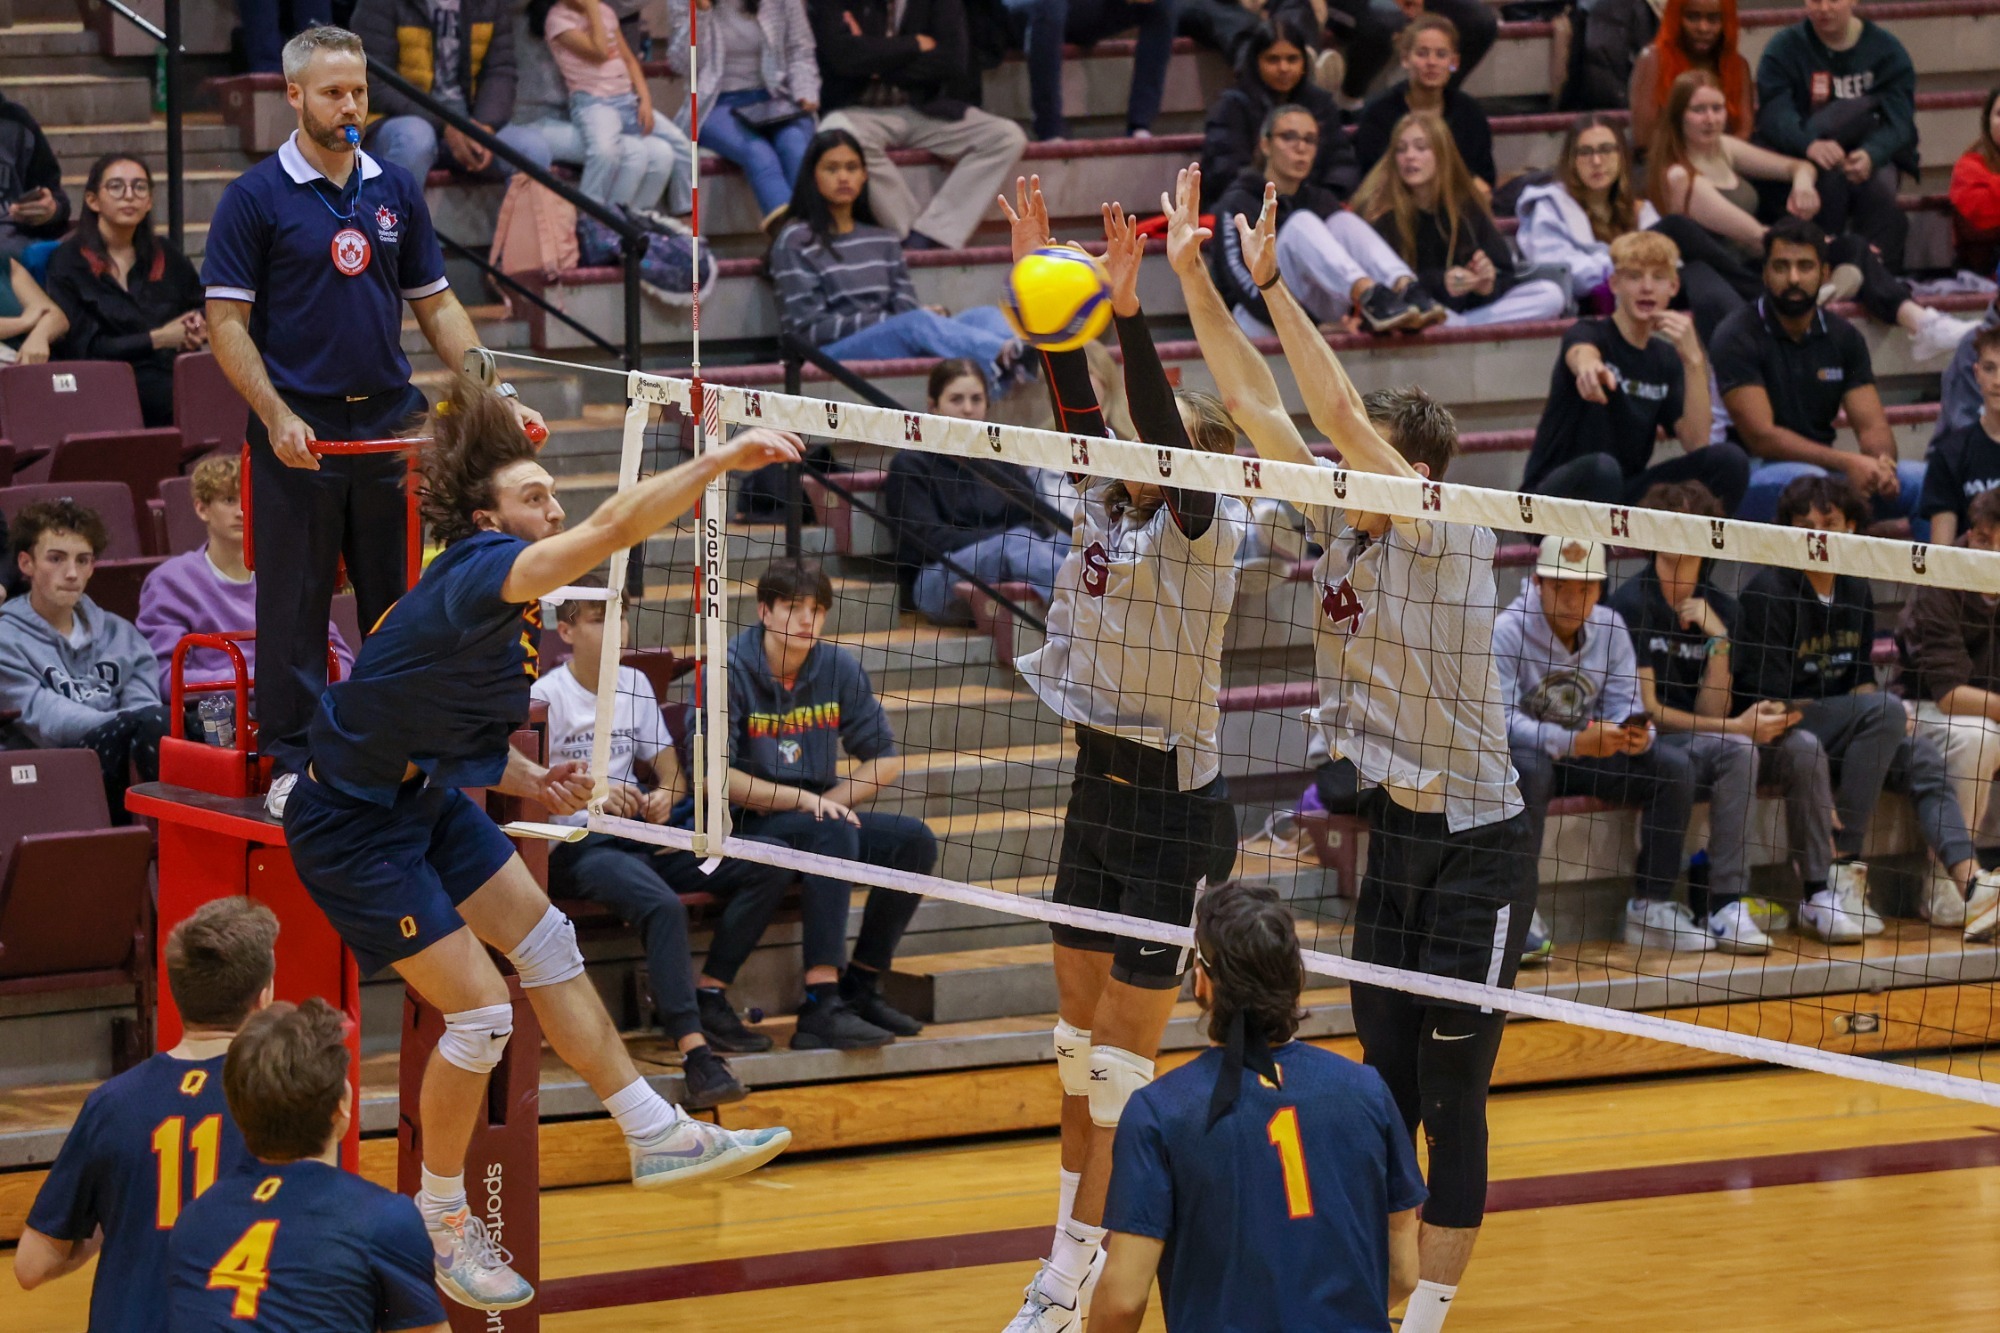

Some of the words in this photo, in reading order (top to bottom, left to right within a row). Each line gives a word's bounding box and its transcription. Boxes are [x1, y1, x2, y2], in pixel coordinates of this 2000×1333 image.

[707, 518, 719, 618] Senoh
[399, 915, 418, 938] Q
[179, 1068, 209, 1096] Q
[151, 1114, 222, 1230] 11
[253, 1175, 283, 1202] Q
[483, 1162, 505, 1242] sports
[1266, 1105, 1314, 1219] 1
[205, 1219, 280, 1319] 4
